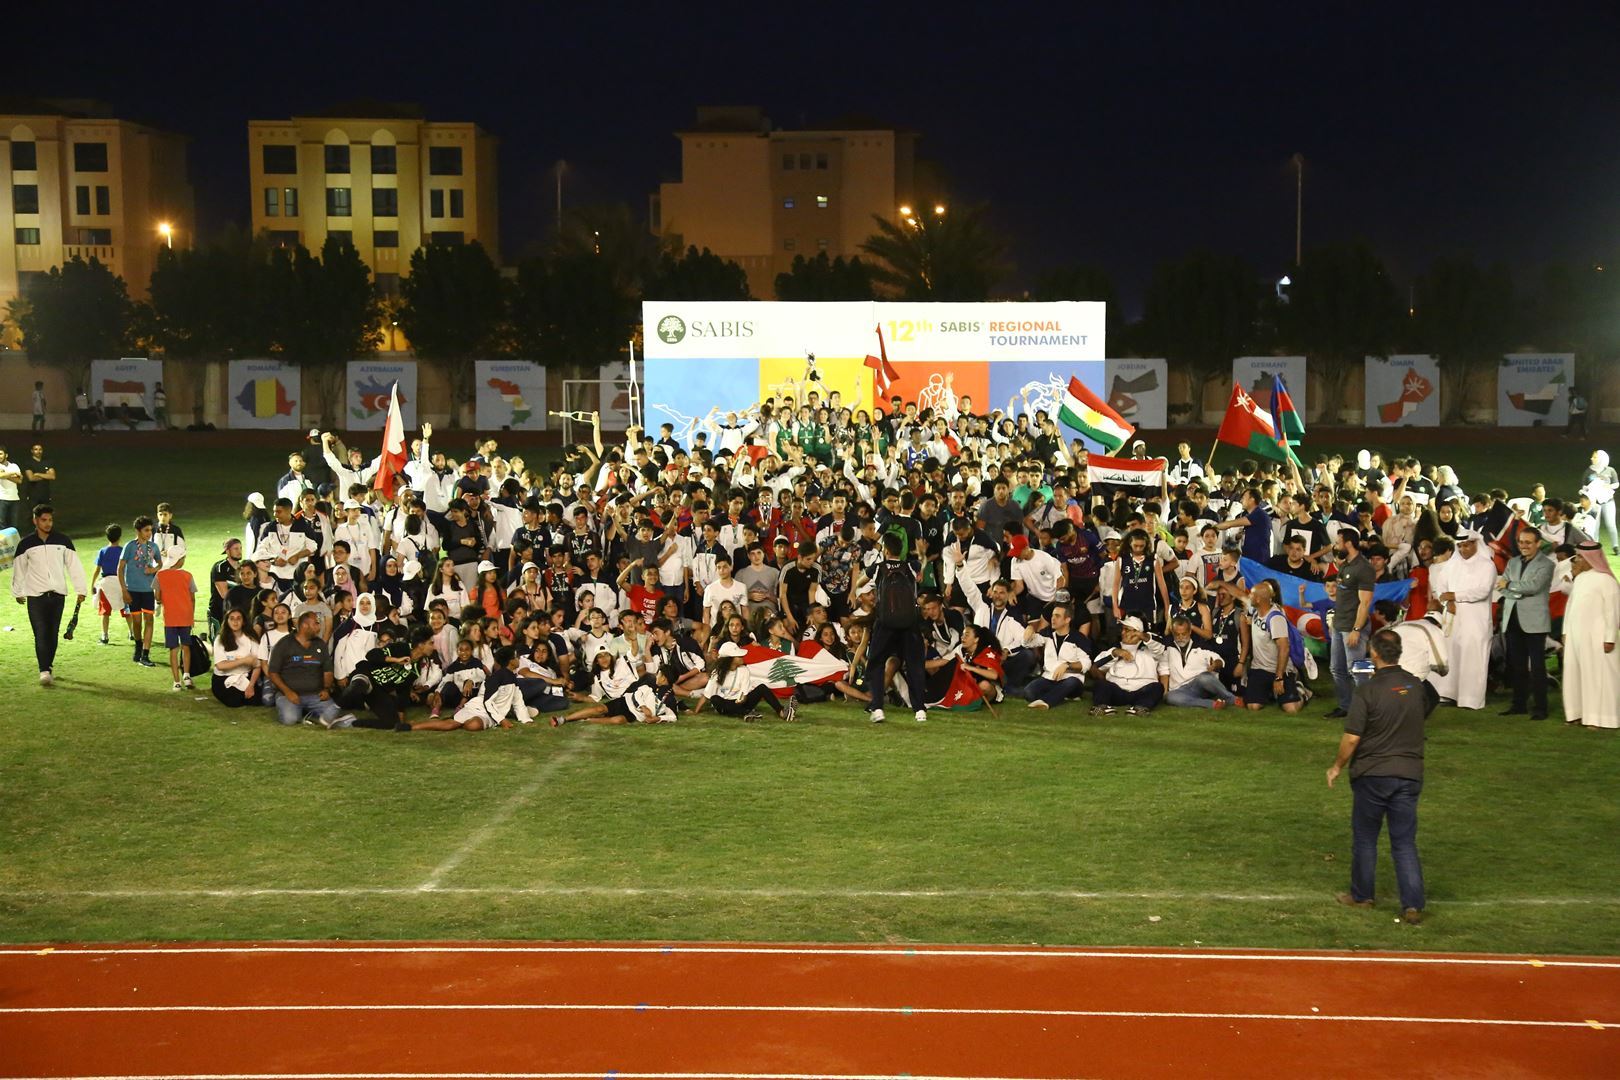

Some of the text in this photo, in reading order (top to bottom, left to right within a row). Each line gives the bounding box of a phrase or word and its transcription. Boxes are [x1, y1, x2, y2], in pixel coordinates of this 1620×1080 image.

[691, 320, 754, 338] SABIS
[887, 319, 1062, 342] 12th SABIS REGIONAL
[989, 335, 1088, 346] TOURNAMENT
[1250, 362, 1288, 370] GERMANY
[1124, 565, 1131, 574] 3
